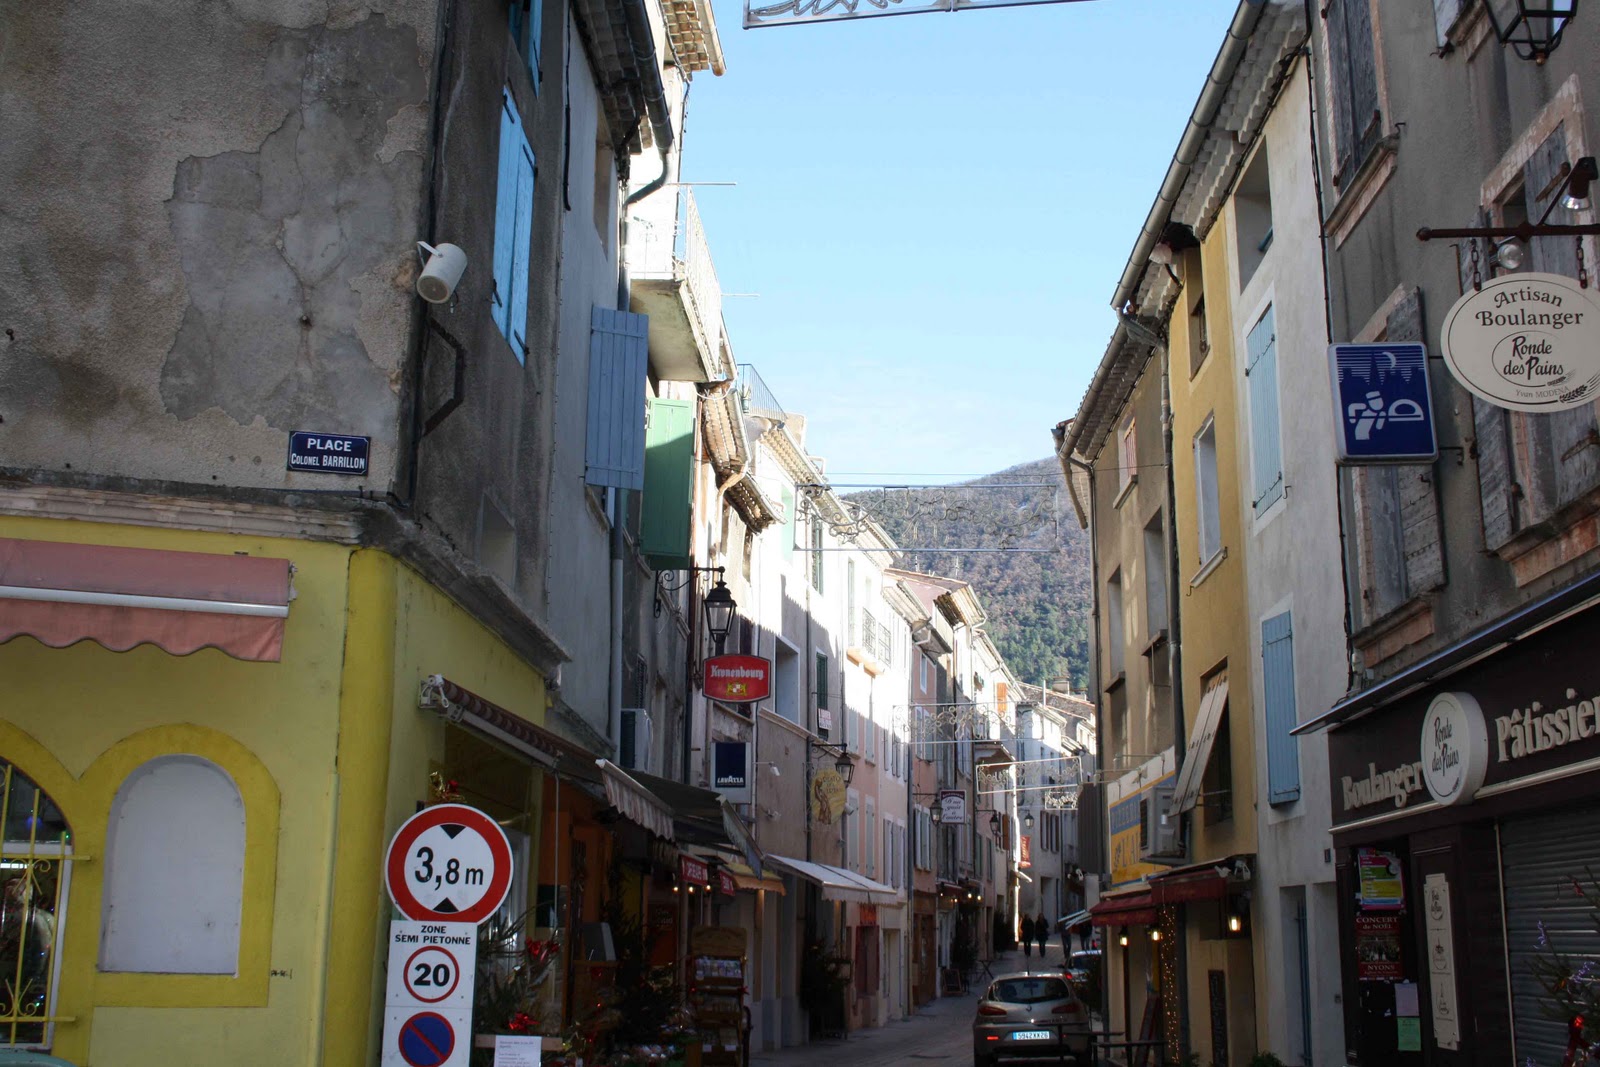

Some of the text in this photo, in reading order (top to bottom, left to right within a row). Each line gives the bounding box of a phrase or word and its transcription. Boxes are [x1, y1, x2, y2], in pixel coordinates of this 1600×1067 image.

[1494, 286, 1563, 308] Artisan
[1475, 309, 1584, 329] Boulanger
[1511, 335, 1552, 359] Ronde
[1503, 355, 1564, 380] des Pains
[1516, 385, 1569, 398] Yvan MODENA
[307, 438, 352, 452] PLACE
[322, 455, 365, 469] BARRILLON
[710, 665, 764, 681] Kronenbourg
[1434, 716, 1453, 748] Ronde
[1432, 744, 1460, 776] des Pains
[1341, 761, 1424, 810] Boulanger
[415, 846, 484, 891] 3,8 m
[421, 925, 447, 934] ZONE
[1356, 916, 1398, 924] CONCERT
[395, 935, 471, 945] SEMI PIETONNE
[413, 963, 450, 986] 20
